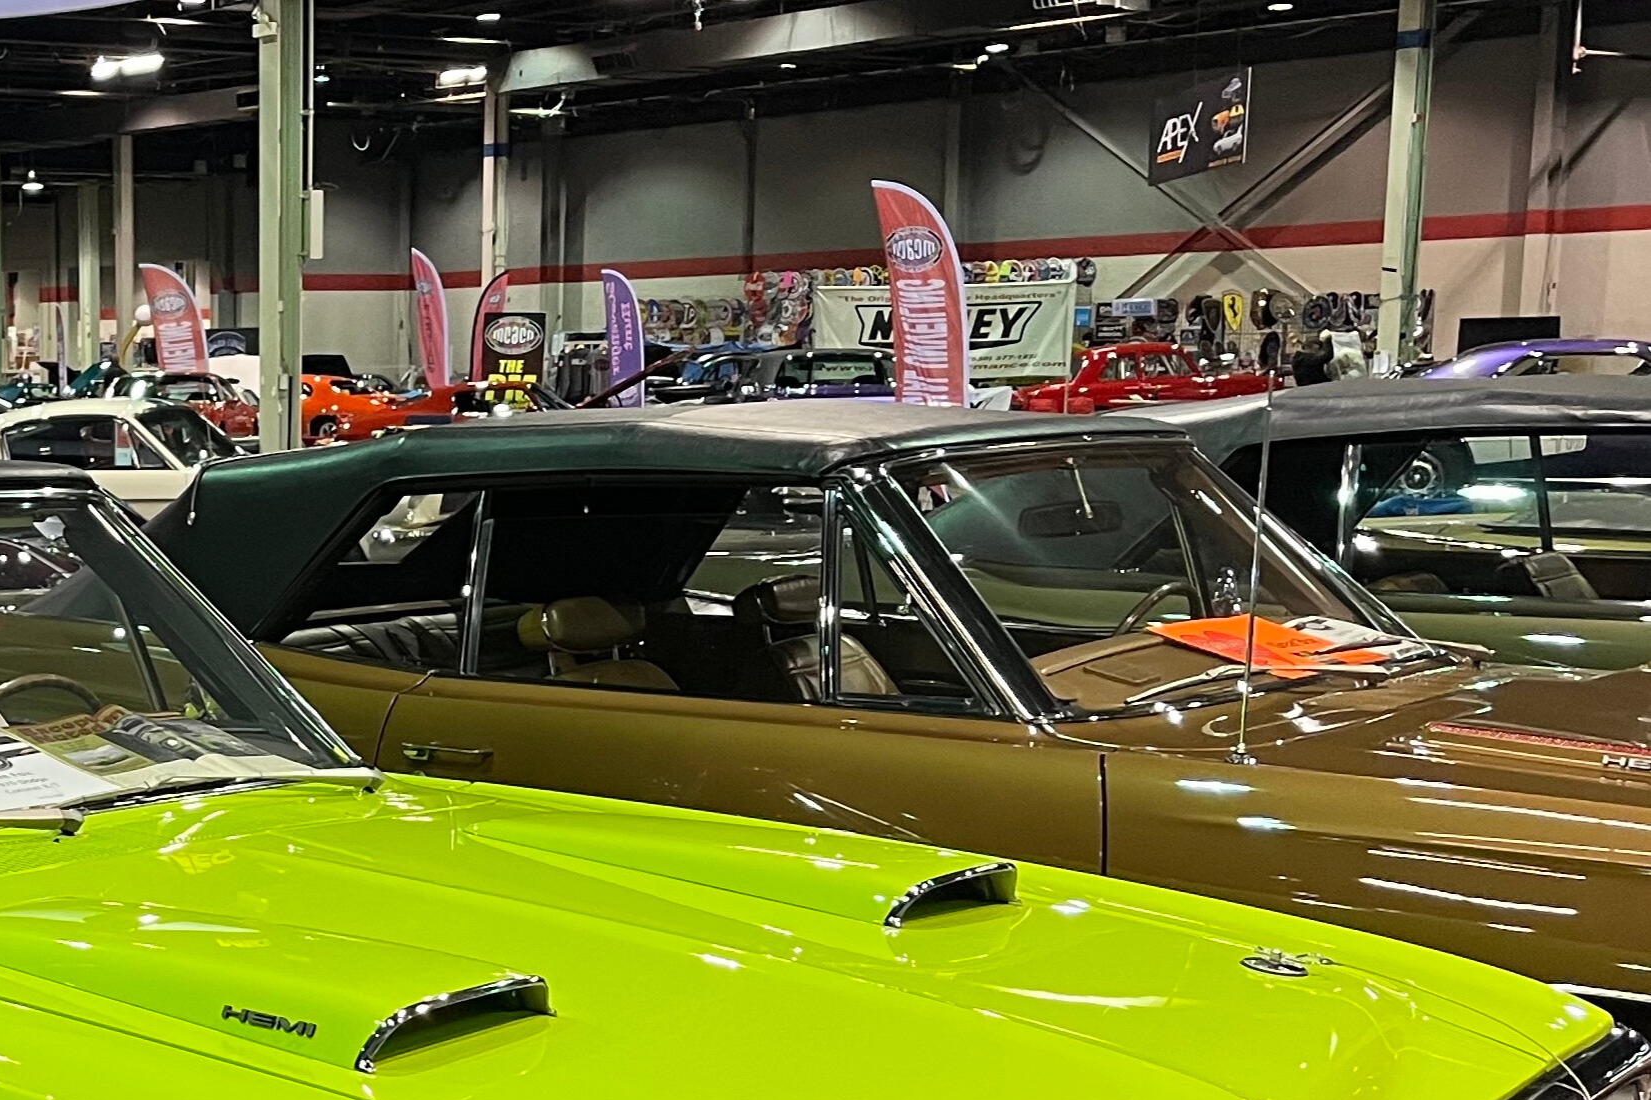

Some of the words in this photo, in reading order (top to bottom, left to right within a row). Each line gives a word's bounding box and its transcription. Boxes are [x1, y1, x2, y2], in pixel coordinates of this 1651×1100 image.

[1157, 101, 1203, 164] APEX
[499, 360, 525, 373] THE
[1602, 754, 1651, 771] HE
[221, 1004, 317, 1038] HEMI
